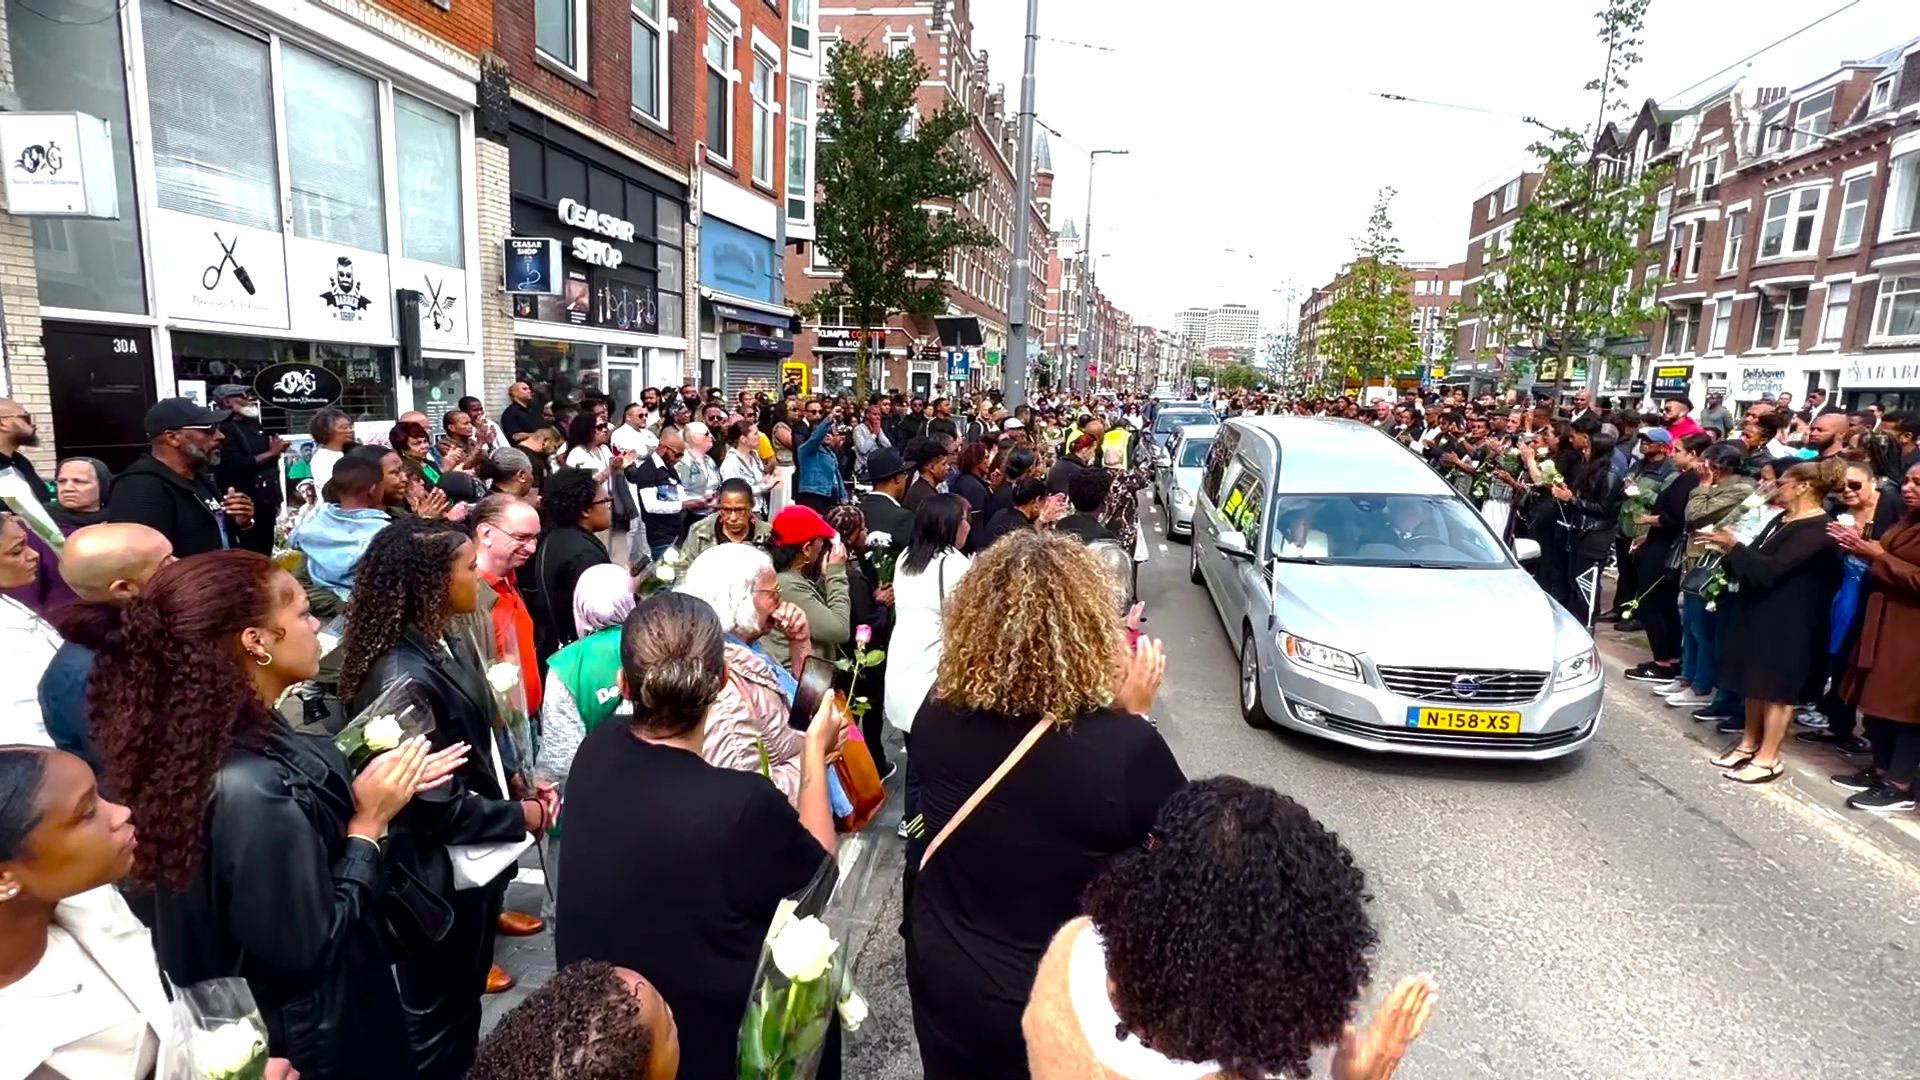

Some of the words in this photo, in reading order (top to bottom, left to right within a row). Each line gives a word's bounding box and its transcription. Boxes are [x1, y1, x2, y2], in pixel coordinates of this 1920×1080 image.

[558, 197, 635, 243] CEASAR
[511, 240, 542, 248] CEASAR
[571, 237, 623, 269] SHOP
[953, 352, 964, 366] P
[1743, 368, 1785, 379] Delfshaven
[1426, 711, 1511, 730] N-158-XS
